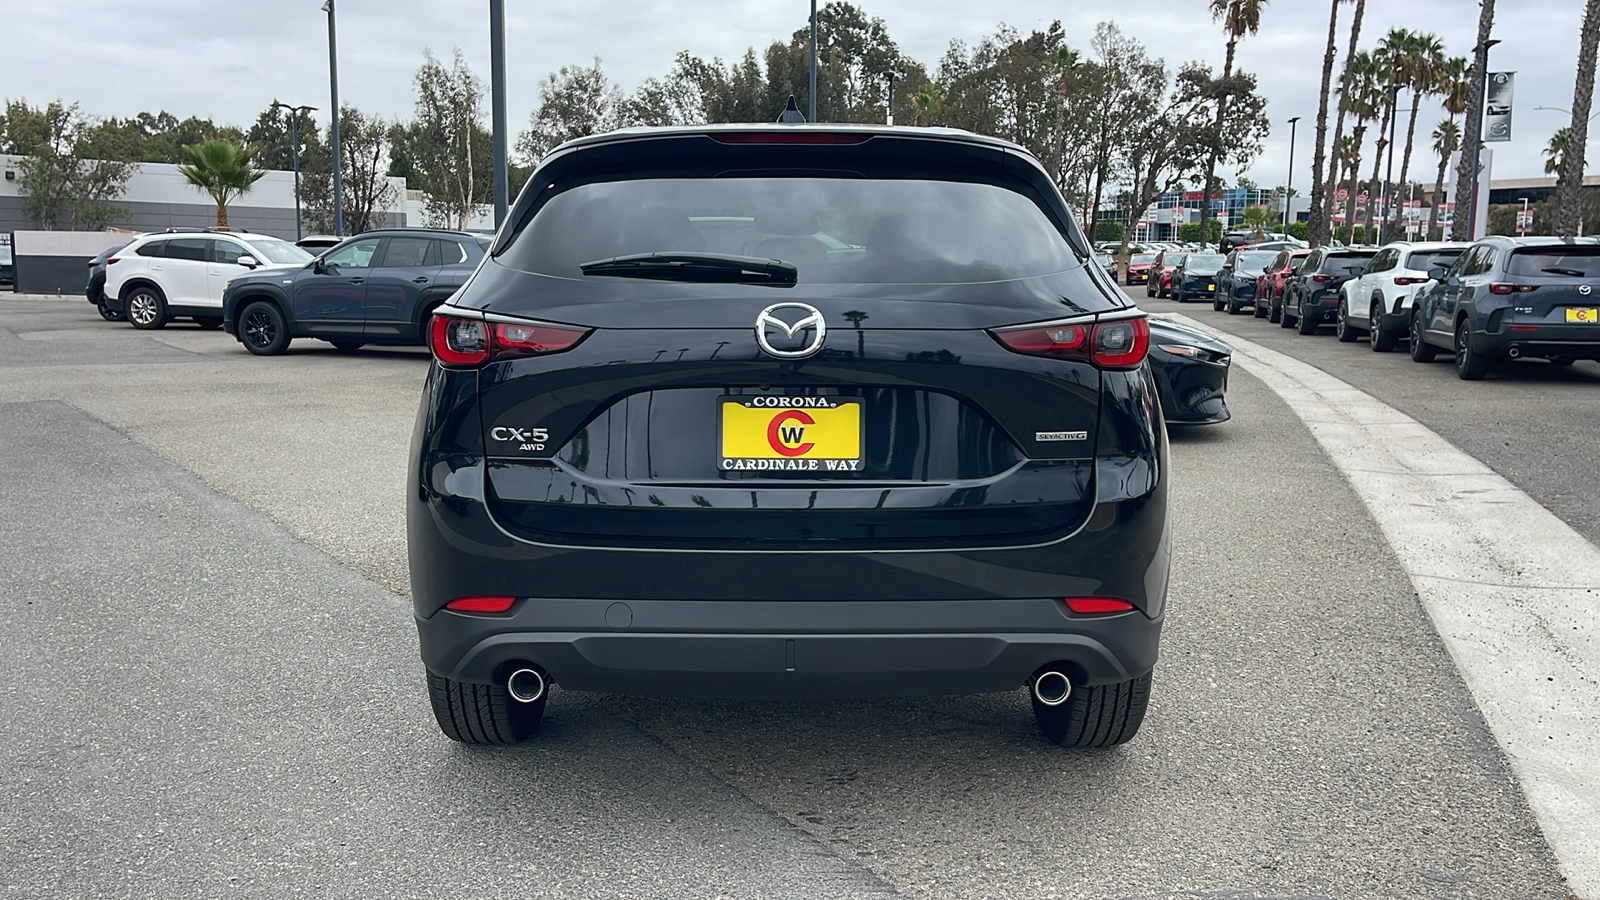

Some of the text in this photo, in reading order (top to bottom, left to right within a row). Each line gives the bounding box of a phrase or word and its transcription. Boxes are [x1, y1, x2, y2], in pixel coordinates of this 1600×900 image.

[753, 397, 829, 408] CORONA
[491, 426, 549, 442] CX-5
[519, 443, 545, 451] AWD
[722, 458, 860, 471] CARDINALE WAY
